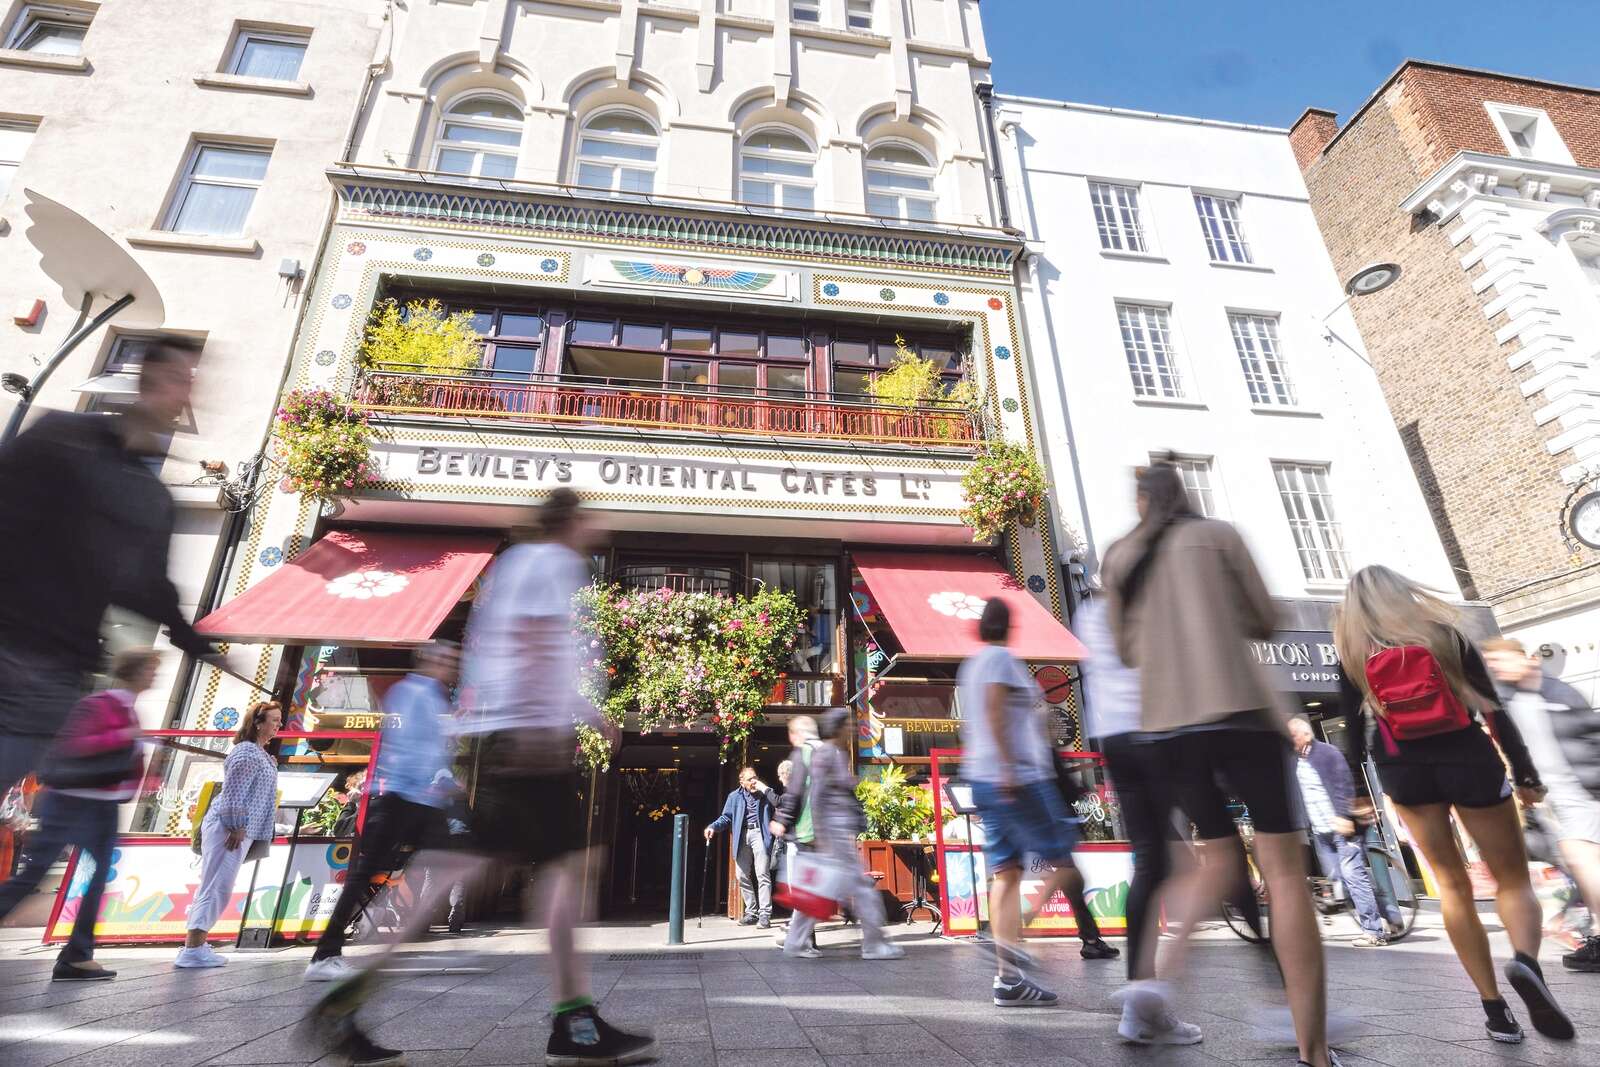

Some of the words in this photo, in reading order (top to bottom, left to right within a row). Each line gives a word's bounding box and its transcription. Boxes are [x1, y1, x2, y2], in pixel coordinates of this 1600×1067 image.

[416, 446, 572, 483] BEWLEY'S
[599, 457, 757, 492] ORIENTAL
[1292, 673, 1341, 681] LONDO
